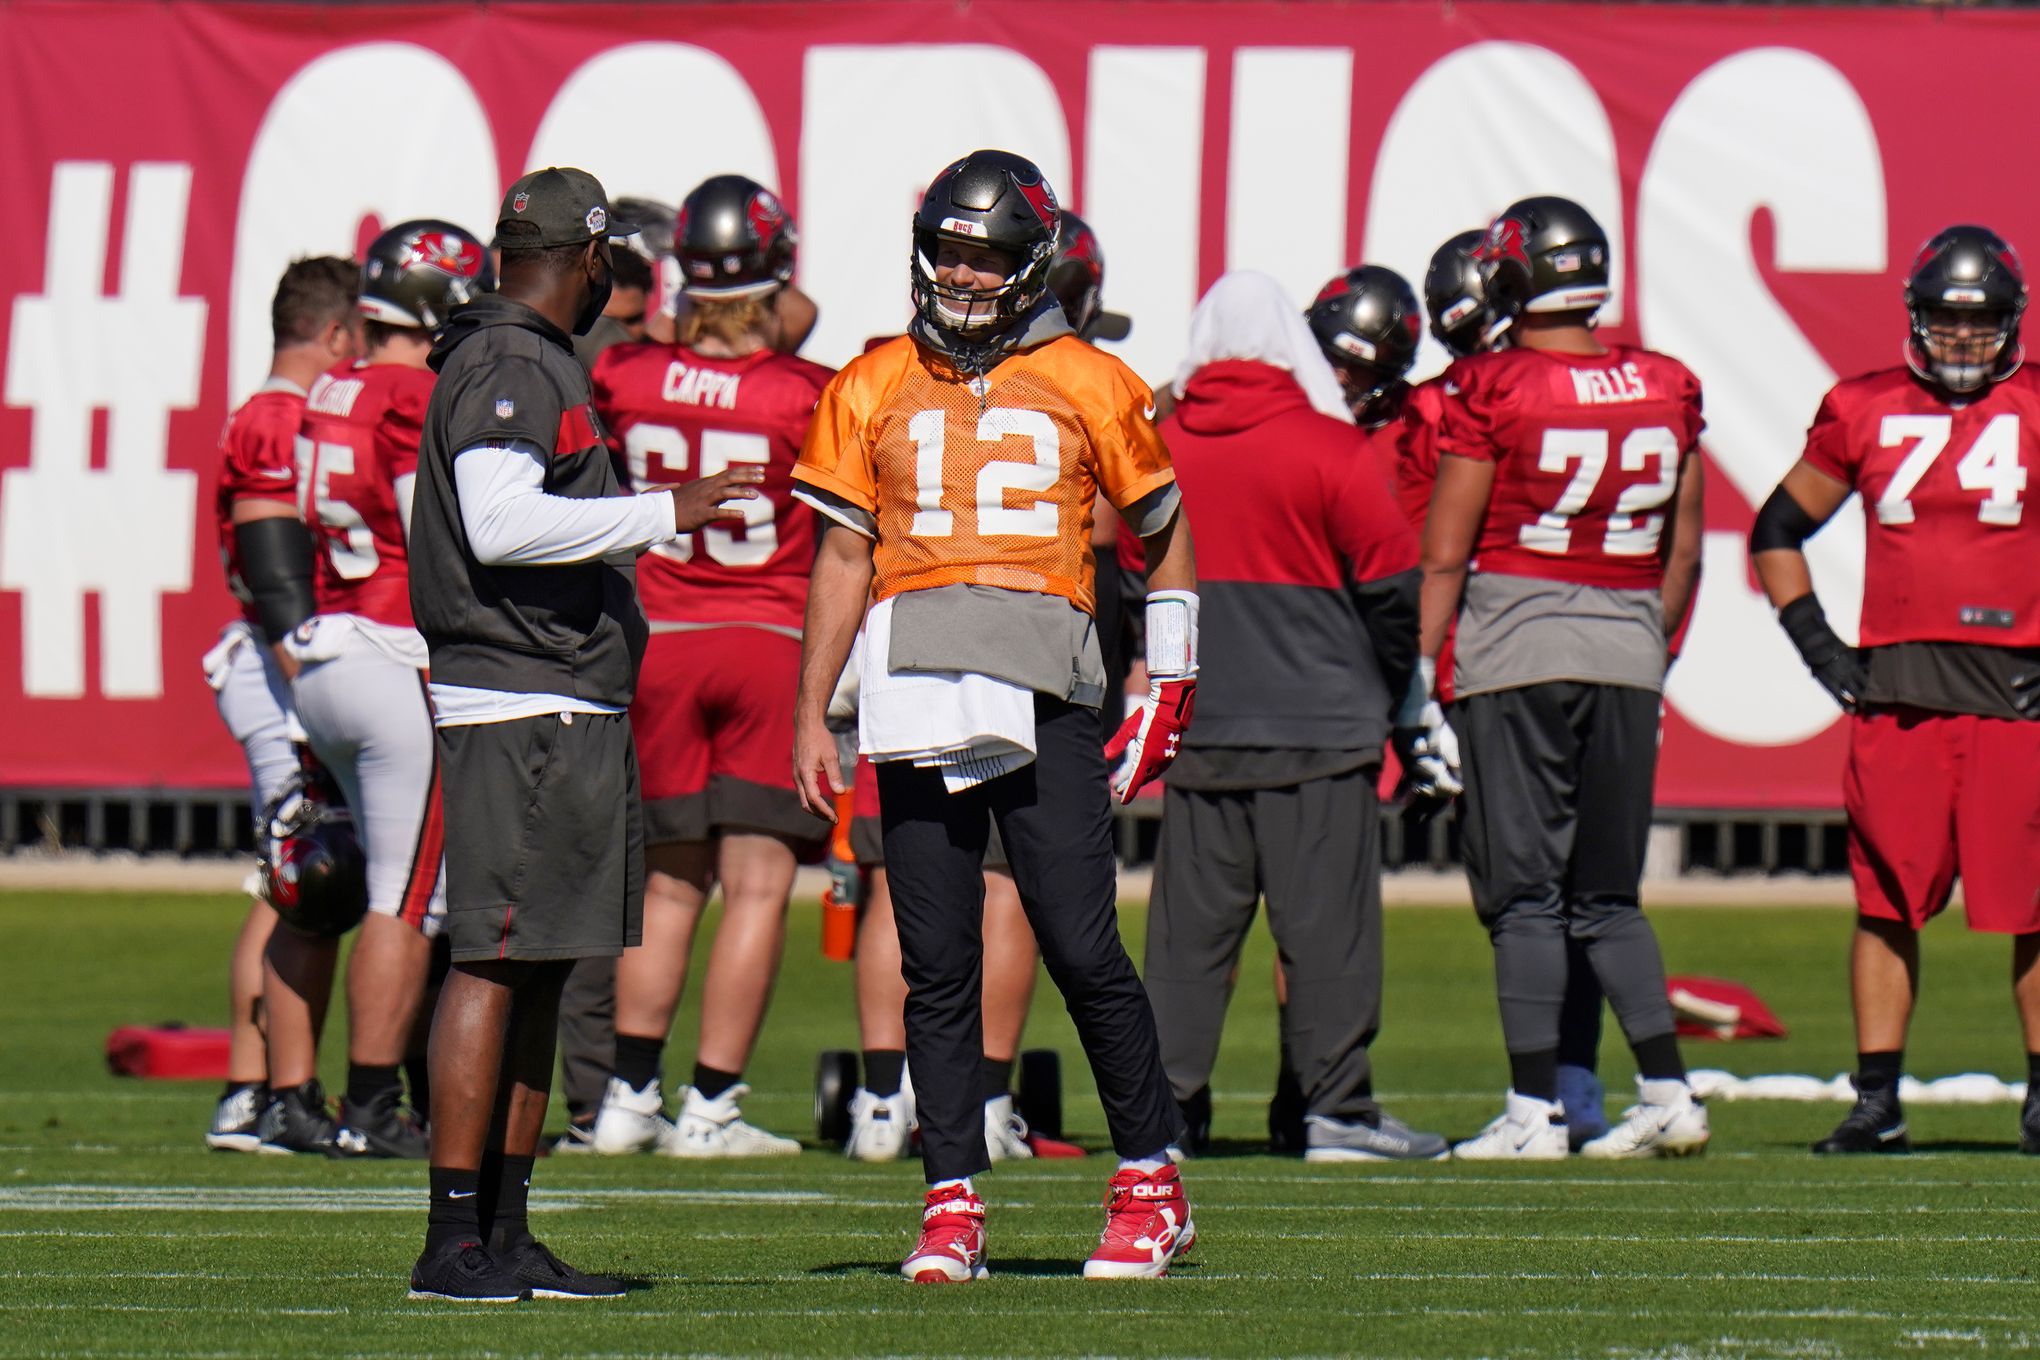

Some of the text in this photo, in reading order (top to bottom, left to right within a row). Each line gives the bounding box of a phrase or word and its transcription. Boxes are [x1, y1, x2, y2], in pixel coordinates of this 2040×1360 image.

[952, 220, 974, 235] BUCS
[1569, 361, 1648, 405] WELLS
[624, 422, 779, 567] 65
[908, 407, 1061, 537] 12
[1517, 426, 1680, 556] 72
[1875, 412, 2028, 527] 74
